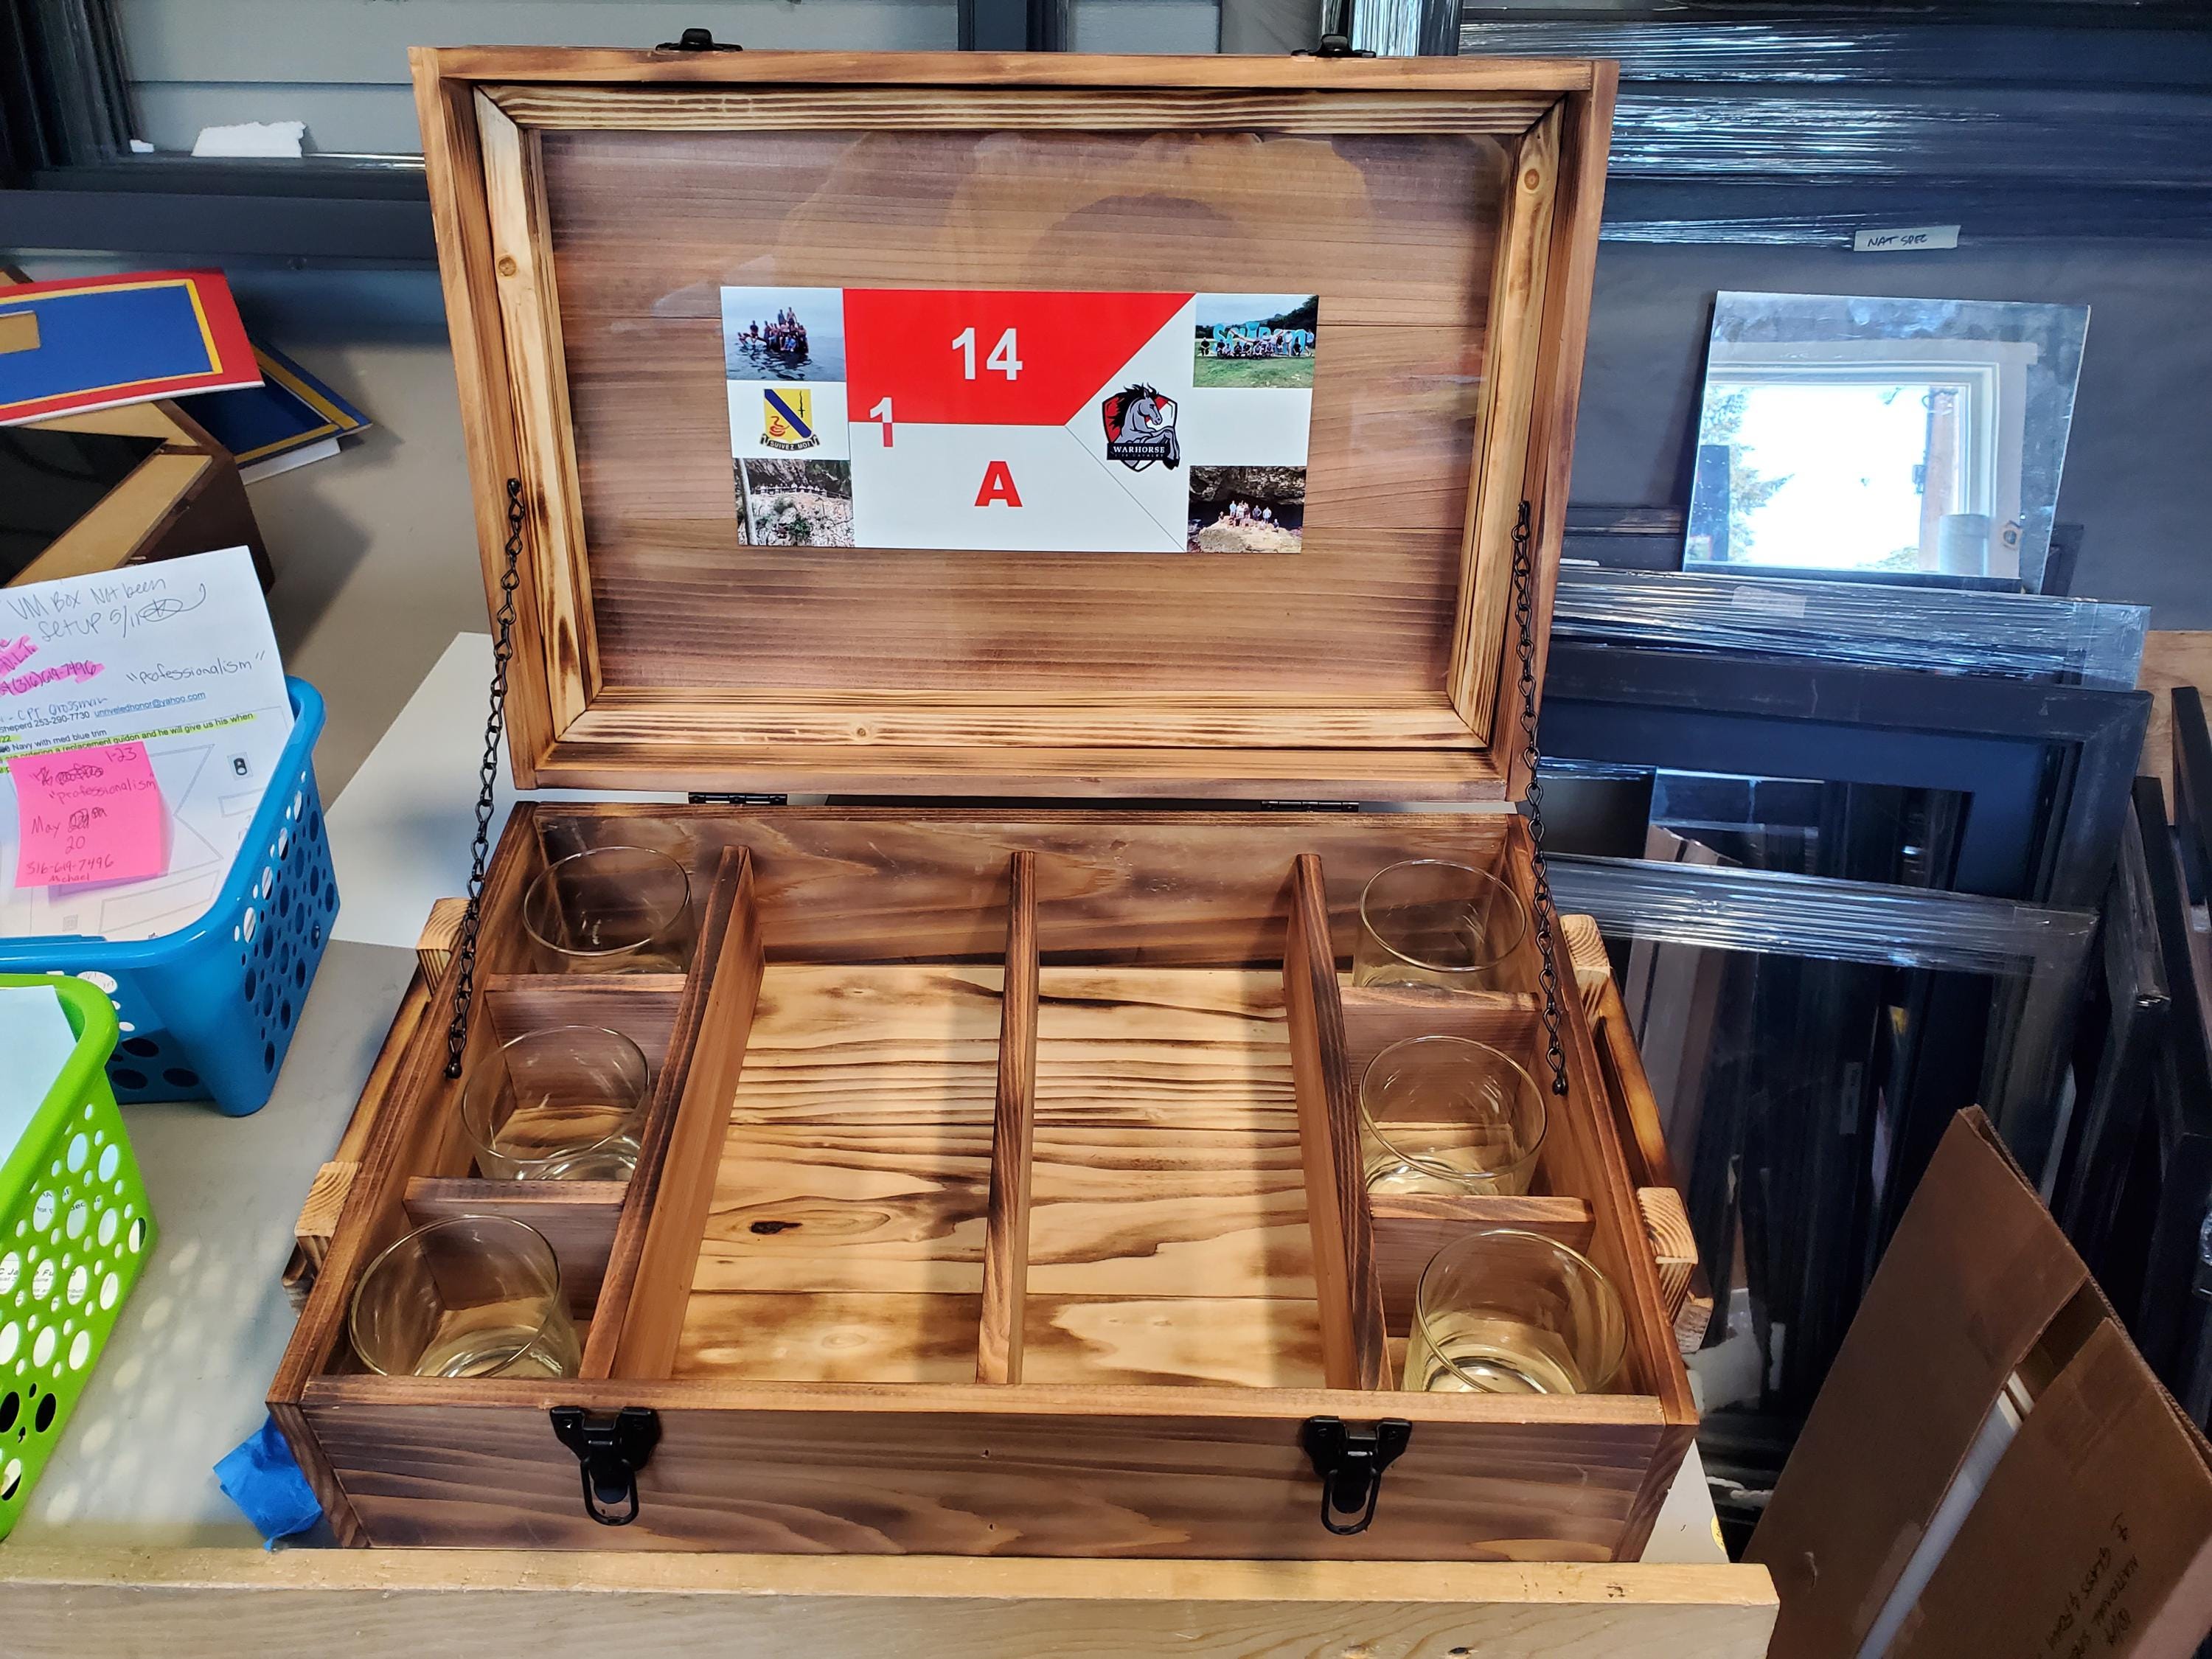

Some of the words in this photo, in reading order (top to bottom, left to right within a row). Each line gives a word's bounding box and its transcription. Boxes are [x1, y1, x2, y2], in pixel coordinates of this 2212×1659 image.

[1867, 236, 1899, 248] NAT
[1900, 234, 1928, 246] SPEC
[951, 327, 1023, 380] 14
[869, 397, 894, 448] 1
[770, 441, 795, 451] SUIVEZ
[796, 441, 811, 449] MOI
[1113, 445, 1166, 454] WARHORSE
[974, 460, 1023, 508] A
[35, 710, 91, 728] 253-290-7730
[142, 731, 157, 740] and
[158, 728, 169, 737] he
[170, 726, 184, 734] will
[184, 723, 201, 734] give
[215, 717, 229, 726] his
[230, 712, 254, 723] when
[12, 742, 33, 751] Navy
[35, 738, 52, 748] with
[52, 734, 72, 745] med
[72, 733, 91, 741] blue
[91, 728, 108, 738] trim
[105, 747, 137, 762] 1-23
[31, 815, 62, 839] May
[65, 835, 86, 855] 20
